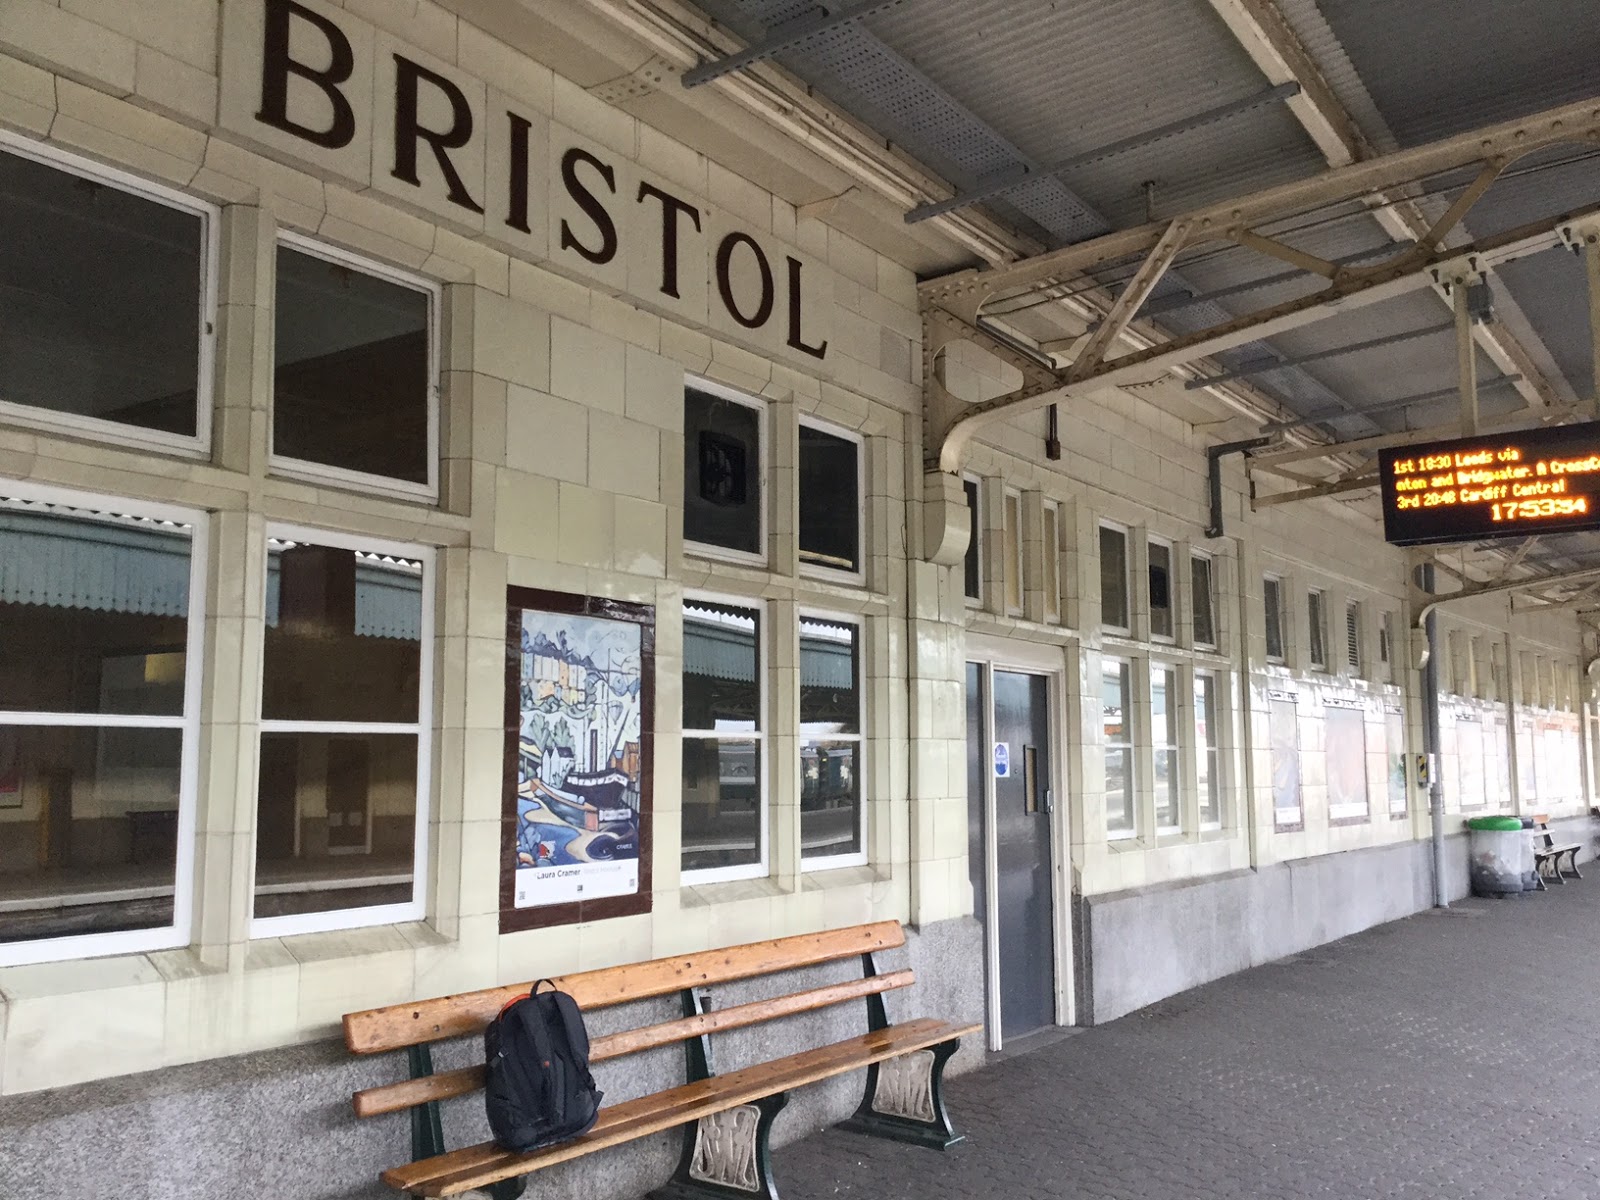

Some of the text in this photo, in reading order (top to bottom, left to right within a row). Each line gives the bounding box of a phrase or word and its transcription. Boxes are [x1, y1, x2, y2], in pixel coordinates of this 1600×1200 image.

[254, 0, 828, 360] BRISTOL
[1394, 447, 1519, 474] 1st 18:30 Leeds via
[1431, 473, 1454, 487] and
[1457, 466, 1533, 484] Bridgwater.
[1536, 462, 1547, 476] A
[1397, 494, 1420, 509] 3rd
[1460, 485, 1508, 502] Cardiff
[1512, 478, 1565, 497] Central
[1491, 498, 1587, 520] 17:53:54
[537, 871, 556, 880] Laura
[557, 869, 581, 878] Cramer
